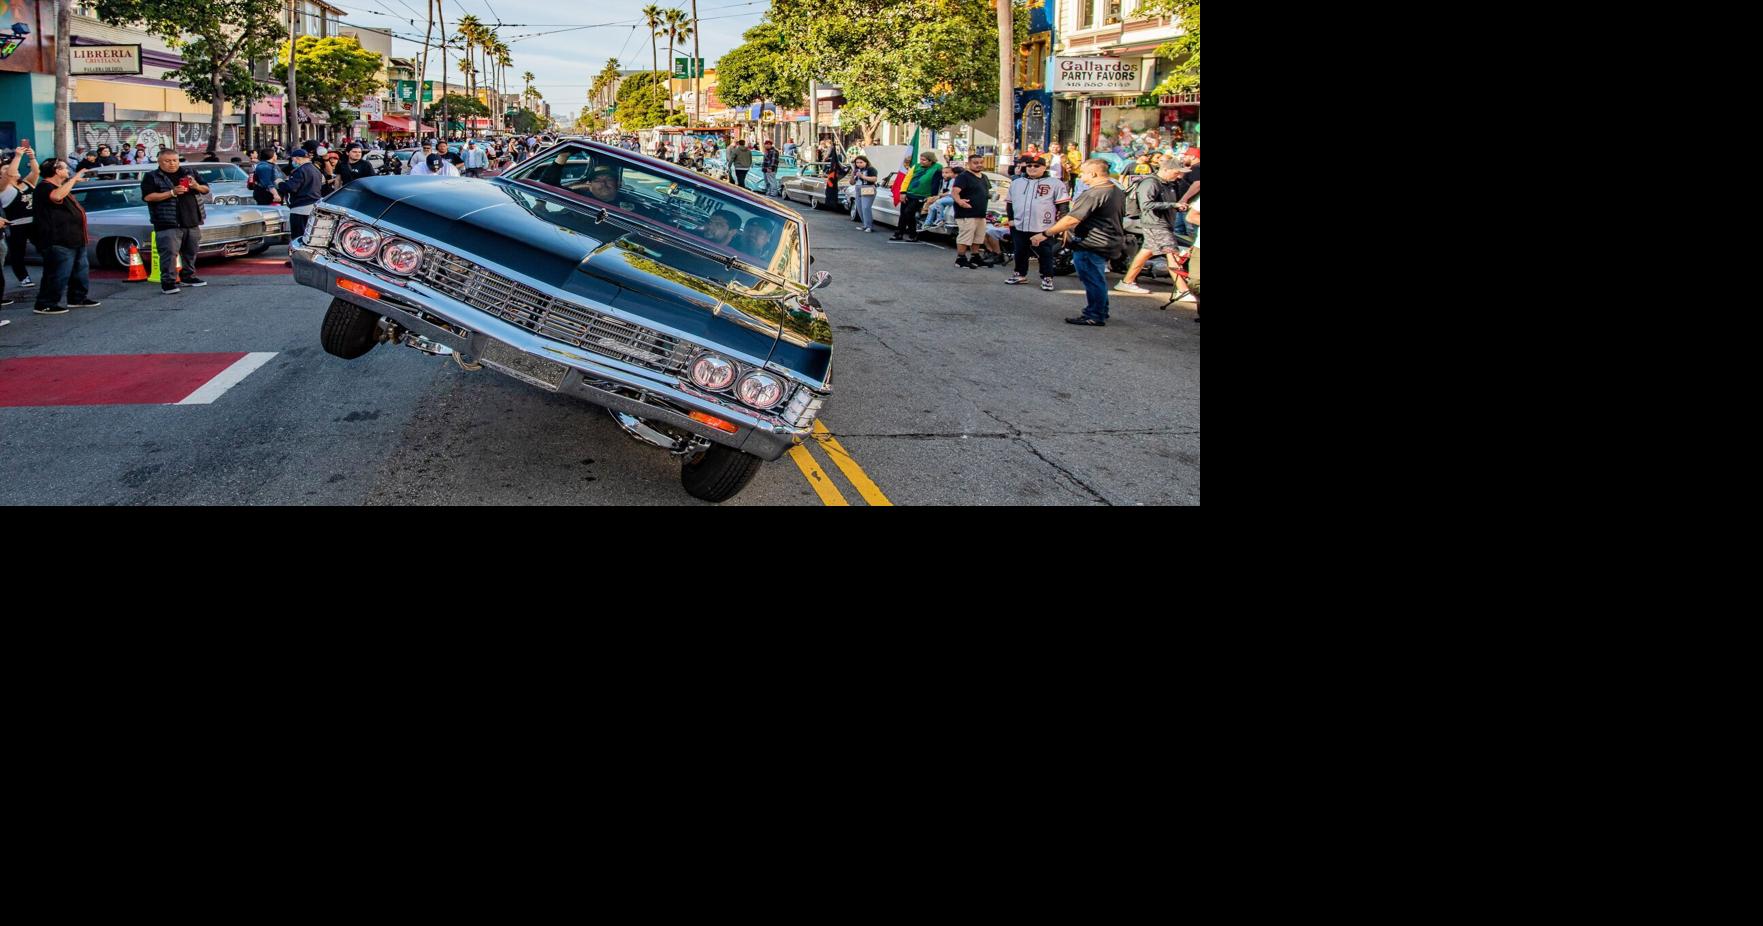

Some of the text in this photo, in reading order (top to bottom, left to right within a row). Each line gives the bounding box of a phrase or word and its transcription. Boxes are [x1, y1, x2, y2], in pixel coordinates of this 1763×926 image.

[1061, 60, 1138, 71] Gallardos
[1061, 72, 1135, 80] PARTY FAVORS
